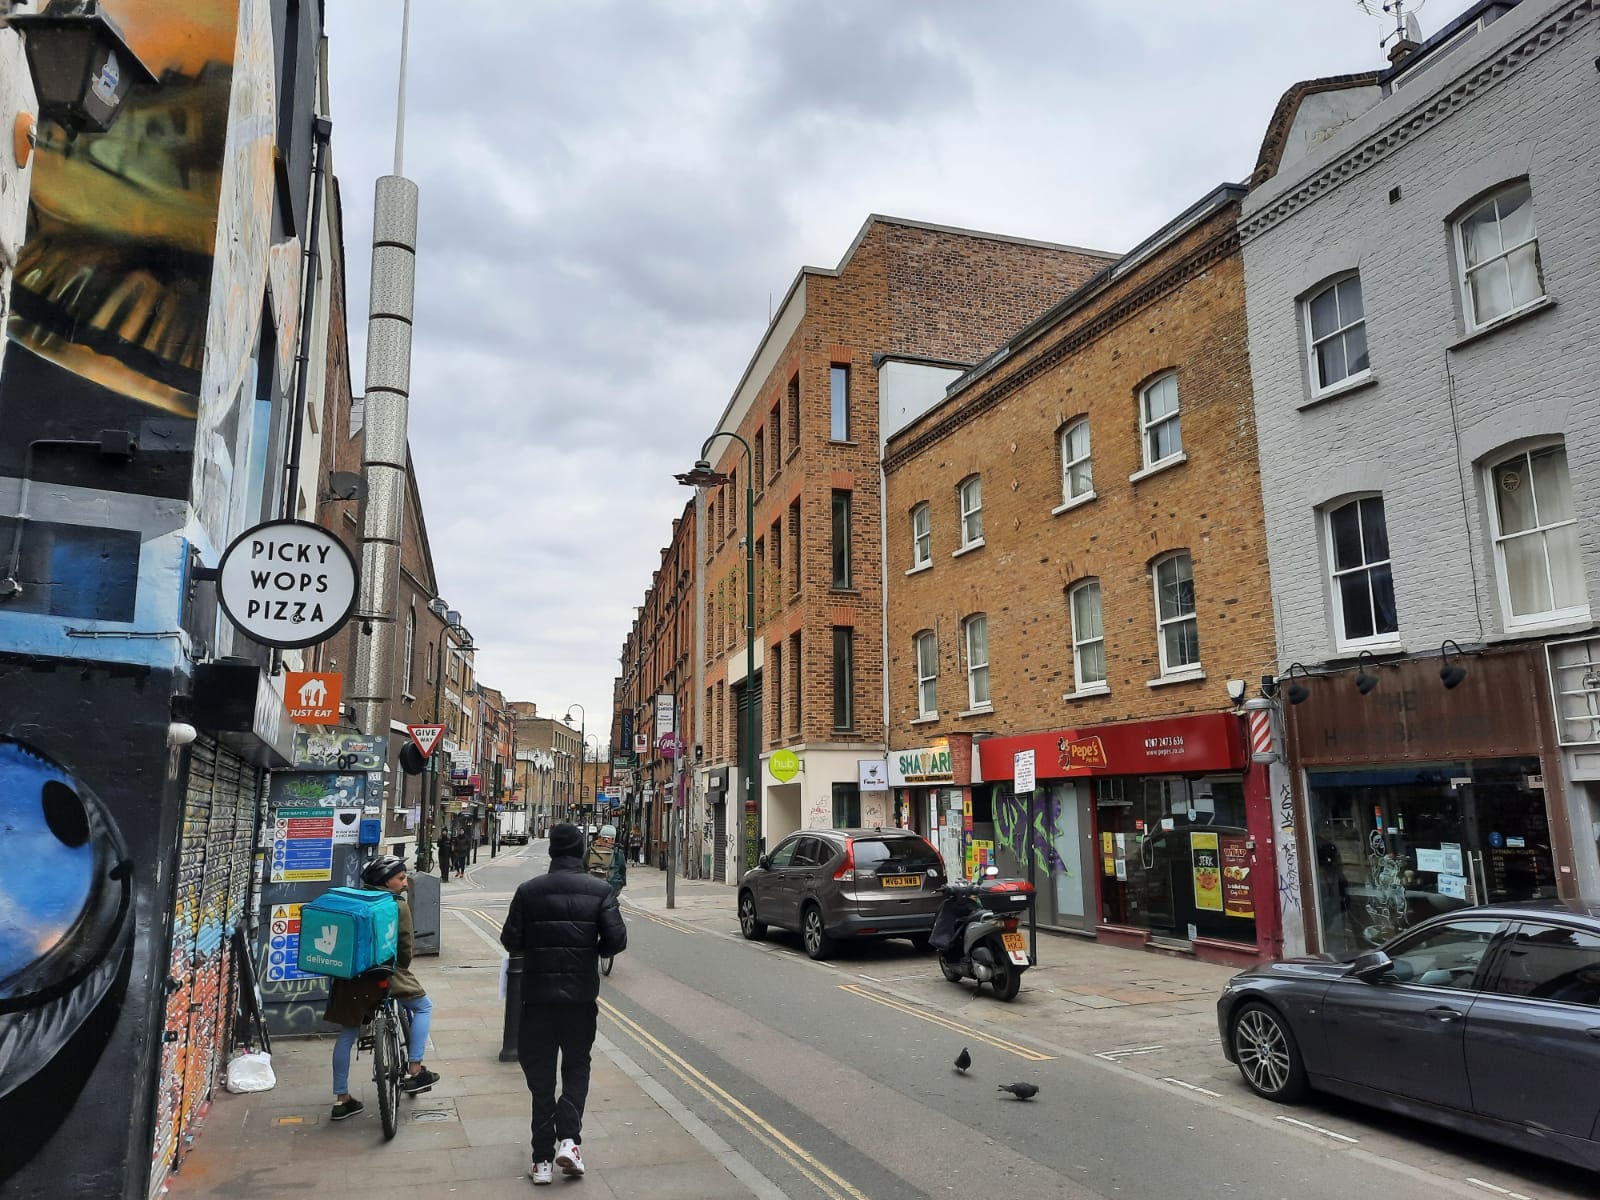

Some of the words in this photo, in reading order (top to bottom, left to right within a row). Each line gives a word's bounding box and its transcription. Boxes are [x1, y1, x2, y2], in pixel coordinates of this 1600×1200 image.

[251, 540, 331, 564] PICKY
[250, 570, 328, 593] WOPS
[247, 599, 324, 623] PIZZA
[290, 709, 313, 718] JUST
[314, 709, 333, 718] EAT
[415, 729, 437, 737] GIVE
[1173, 736, 1184, 746] 636
[1071, 741, 1099, 761] Pepe's
[773, 758, 795, 769] hub
[1198, 855, 1214, 867] JERK
[306, 953, 343, 968] deliveroo
